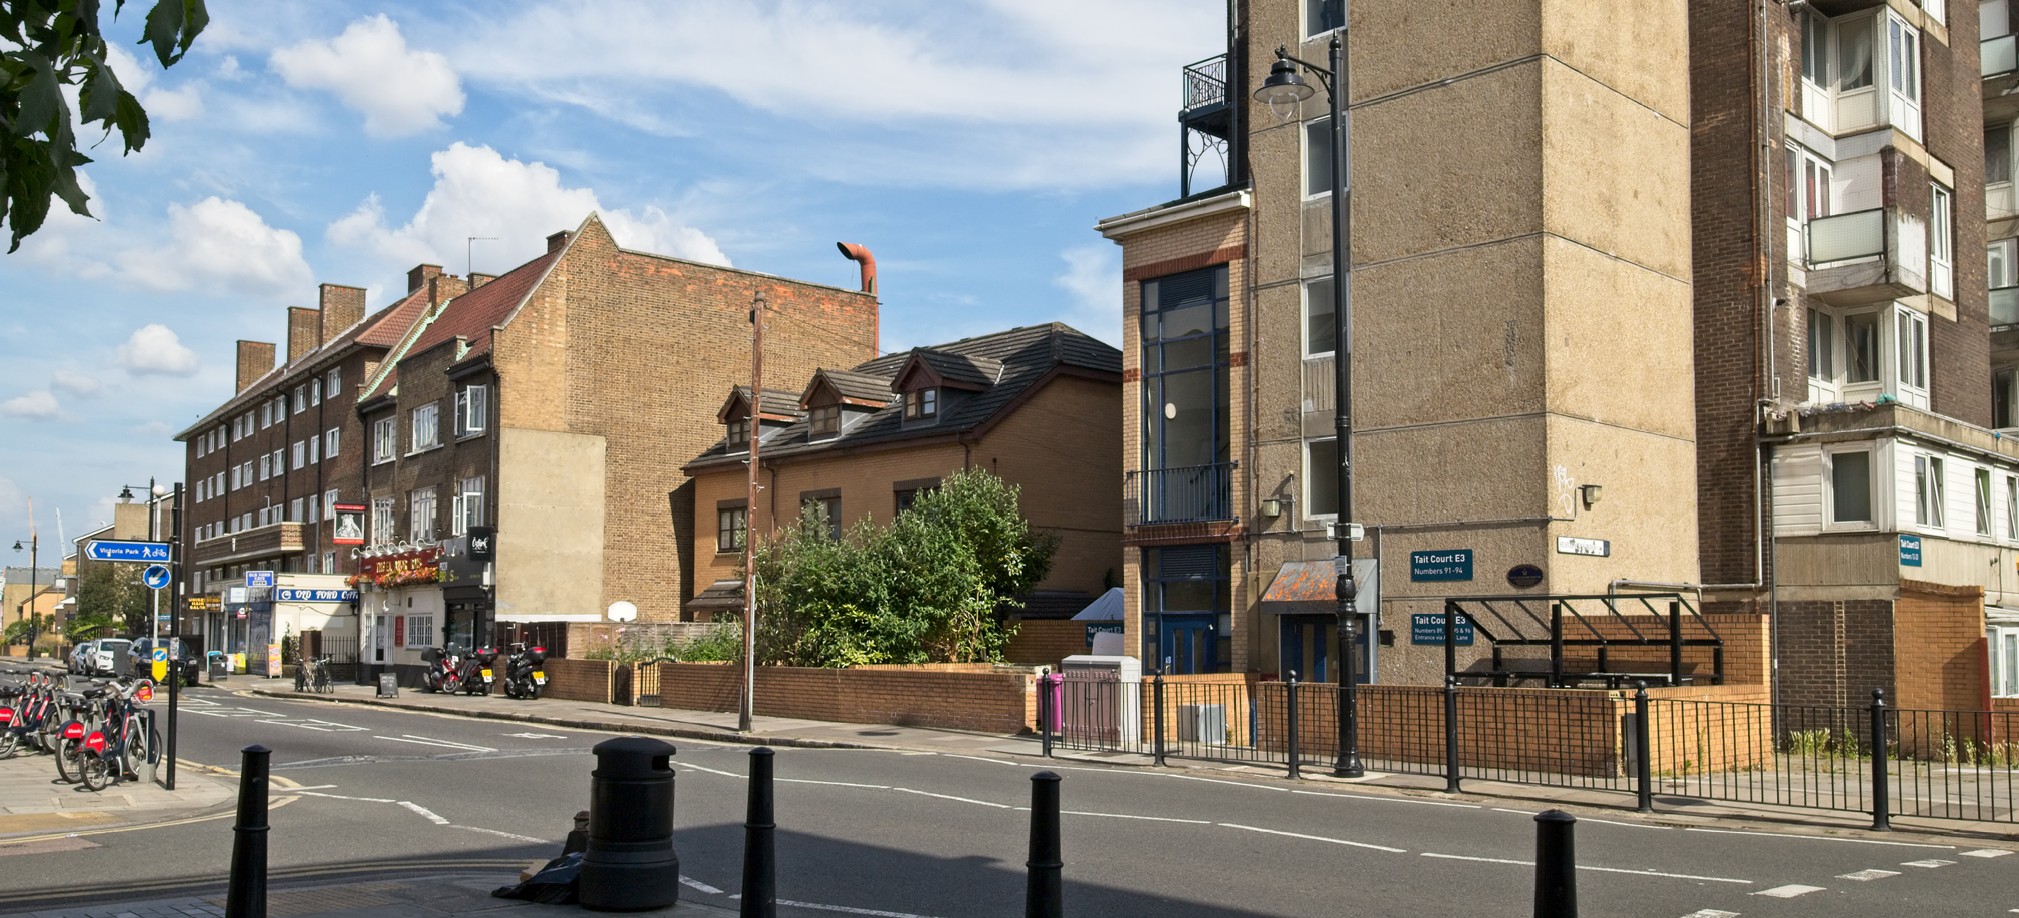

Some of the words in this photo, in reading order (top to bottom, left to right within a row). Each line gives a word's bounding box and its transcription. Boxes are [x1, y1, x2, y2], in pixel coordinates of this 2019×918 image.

[1414, 556, 1429, 564] Tait
[1430, 555, 1453, 563] Court
[1455, 554, 1465, 562] E3
